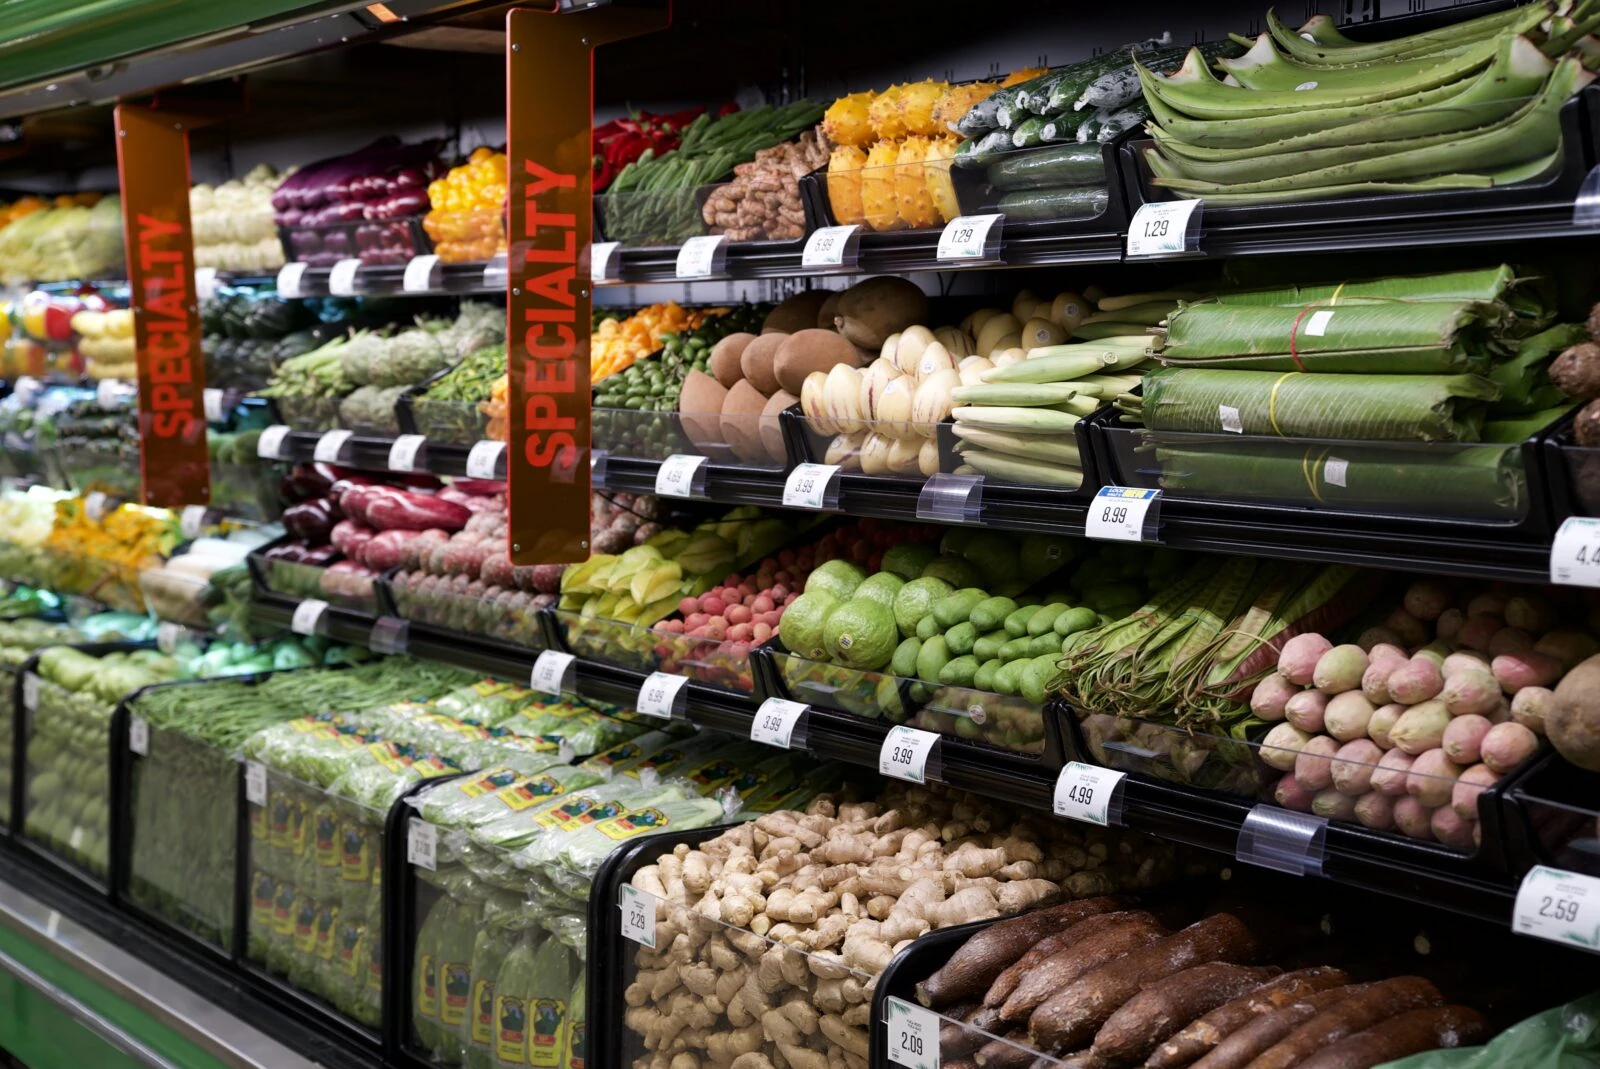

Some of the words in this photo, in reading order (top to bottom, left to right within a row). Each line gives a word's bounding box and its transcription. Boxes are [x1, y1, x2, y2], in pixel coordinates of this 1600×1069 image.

[951, 228, 973, 243] 1.29
[1144, 220, 1170, 238] 1.29
[524, 159, 577, 468] SPECIALTY
[137, 213, 194, 438] SPECIALTY
[795, 478, 815, 493] 3.99
[1102, 506, 1128, 524] 8.99
[1575, 544, 1600, 566] 4.4
[763, 715, 782, 732] 3.99
[892, 746, 913, 765] 3.99
[1068, 785, 1094, 806] 4.99
[1538, 896, 1580, 923] 2.59
[630, 911, 645, 930] 2.29
[901, 1031, 923, 1056] 2.09
